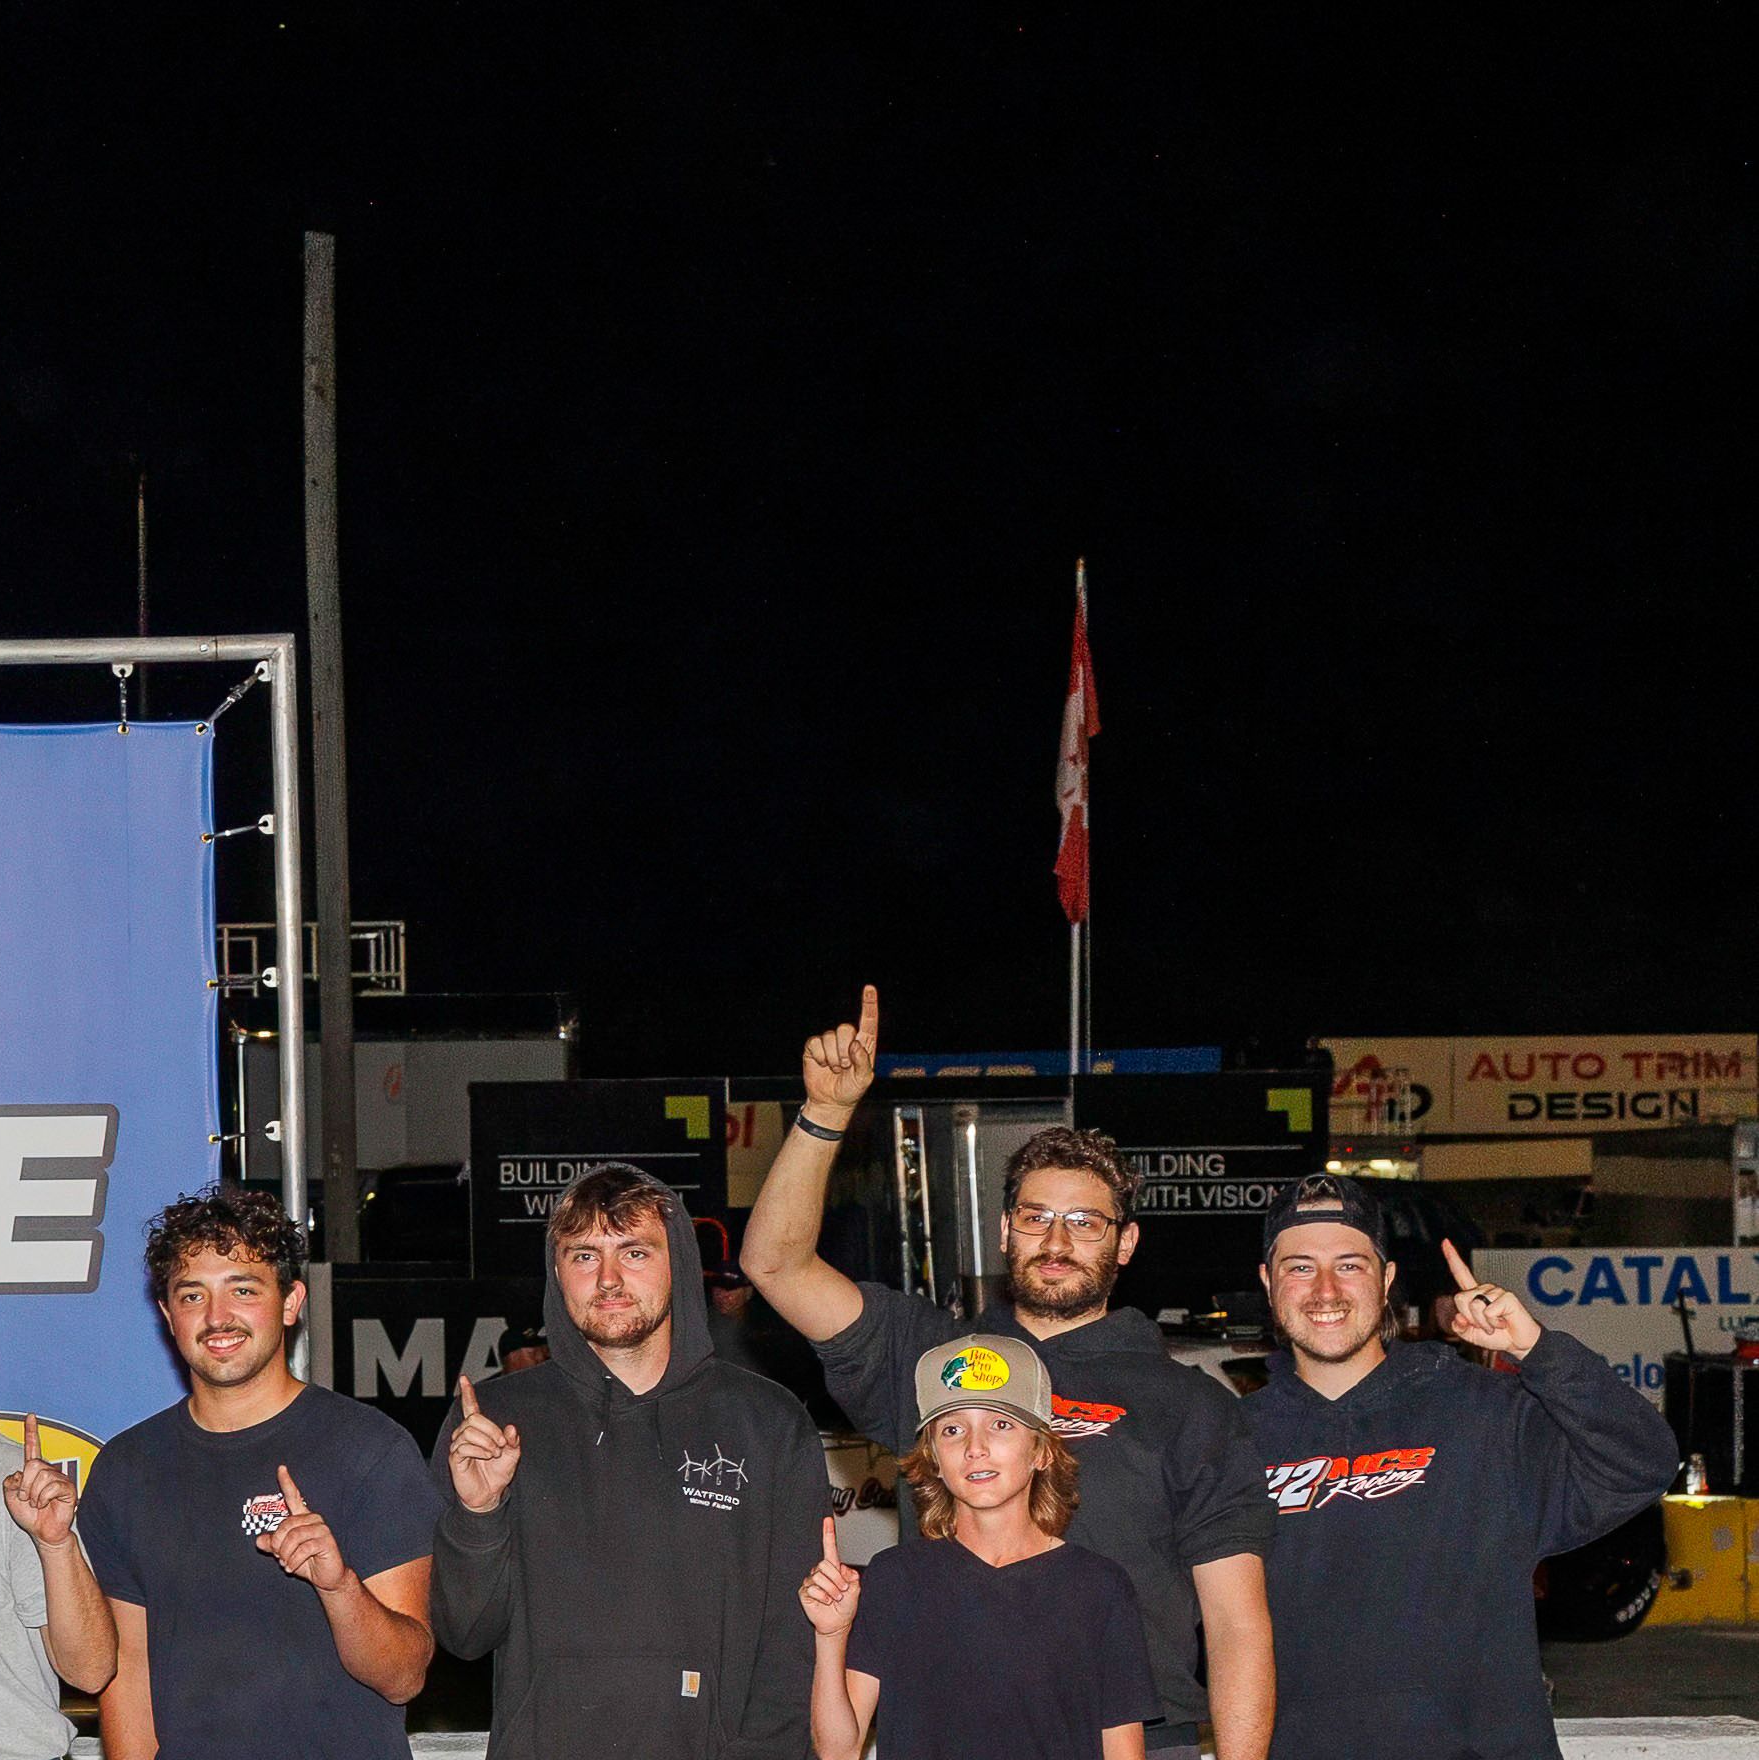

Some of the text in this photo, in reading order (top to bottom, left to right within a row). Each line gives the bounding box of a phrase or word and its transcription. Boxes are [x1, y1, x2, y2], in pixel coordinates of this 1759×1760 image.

[1468, 1050, 1743, 1083] AUTO TRIM
[1507, 1090, 1700, 1122] DESIGN
[499, 1161, 600, 1185] BUILDI
[1133, 1153, 1226, 1177] ILDING
[1527, 1256, 1759, 1307] CATAL
[970, 1349, 998, 1363] Bass
[972, 1361, 992, 1372] Pro
[973, 1371, 1004, 1386] Shops
[682, 1486, 741, 1506] WATFORD
[1315, 1469, 1426, 1509] Racing
